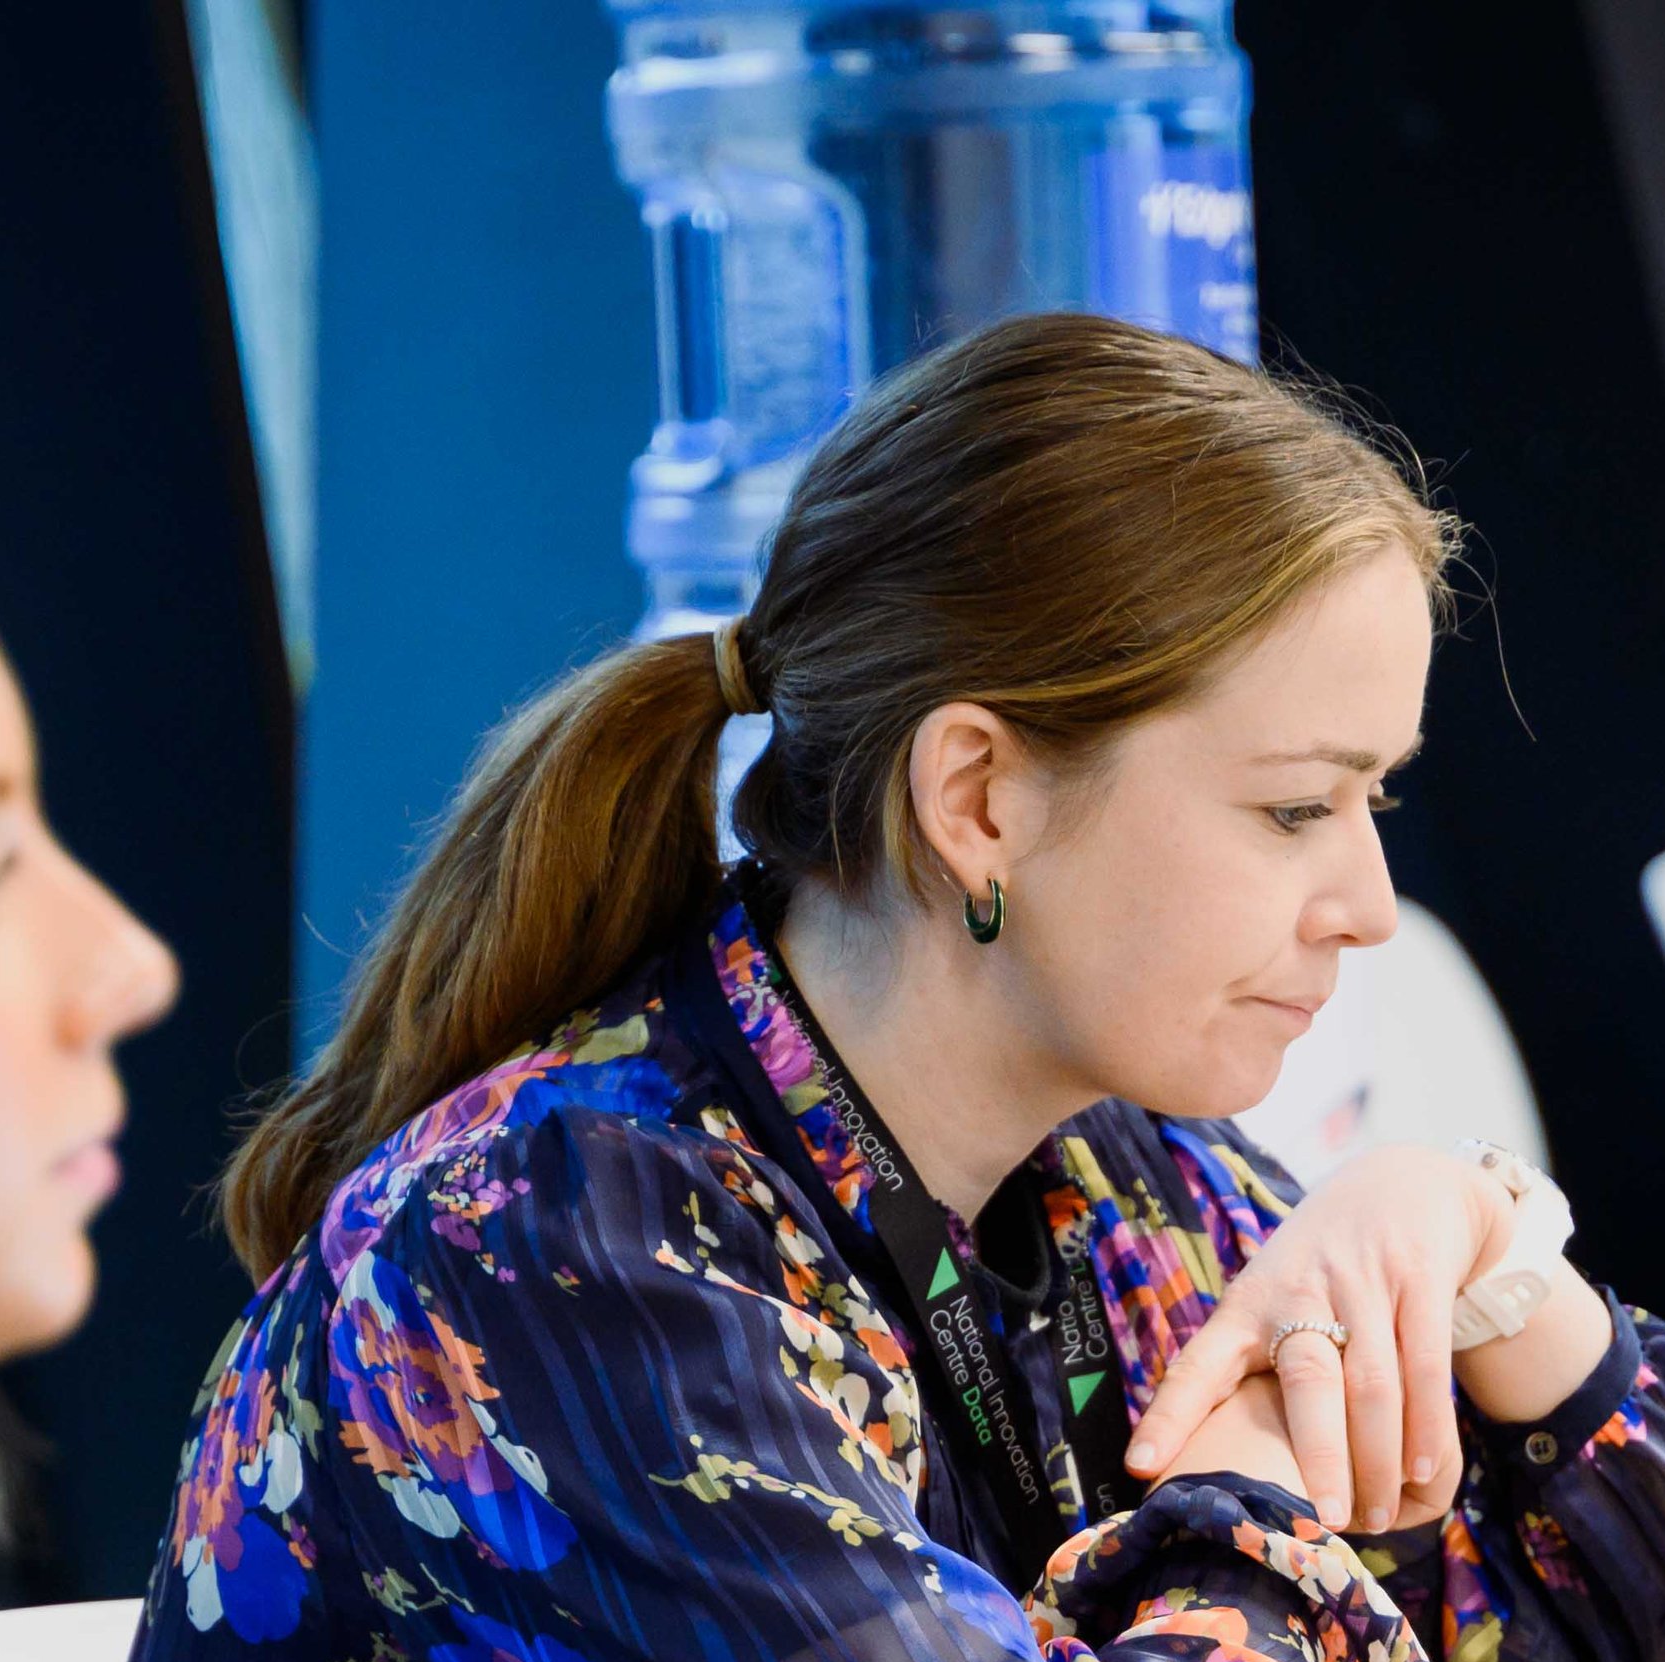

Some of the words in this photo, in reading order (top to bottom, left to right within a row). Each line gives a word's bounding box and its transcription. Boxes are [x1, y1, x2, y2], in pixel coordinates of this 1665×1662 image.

[829, 1078, 904, 1191] Innovation
[1057, 1277, 1085, 1366] Natio
[1077, 1280, 1108, 1359] Centre
[930, 1309, 969, 1385] Centre
[962, 1385, 992, 1445] Data
[949, 1294, 1001, 1391] National
[987, 1388, 1040, 1505] Innovation
